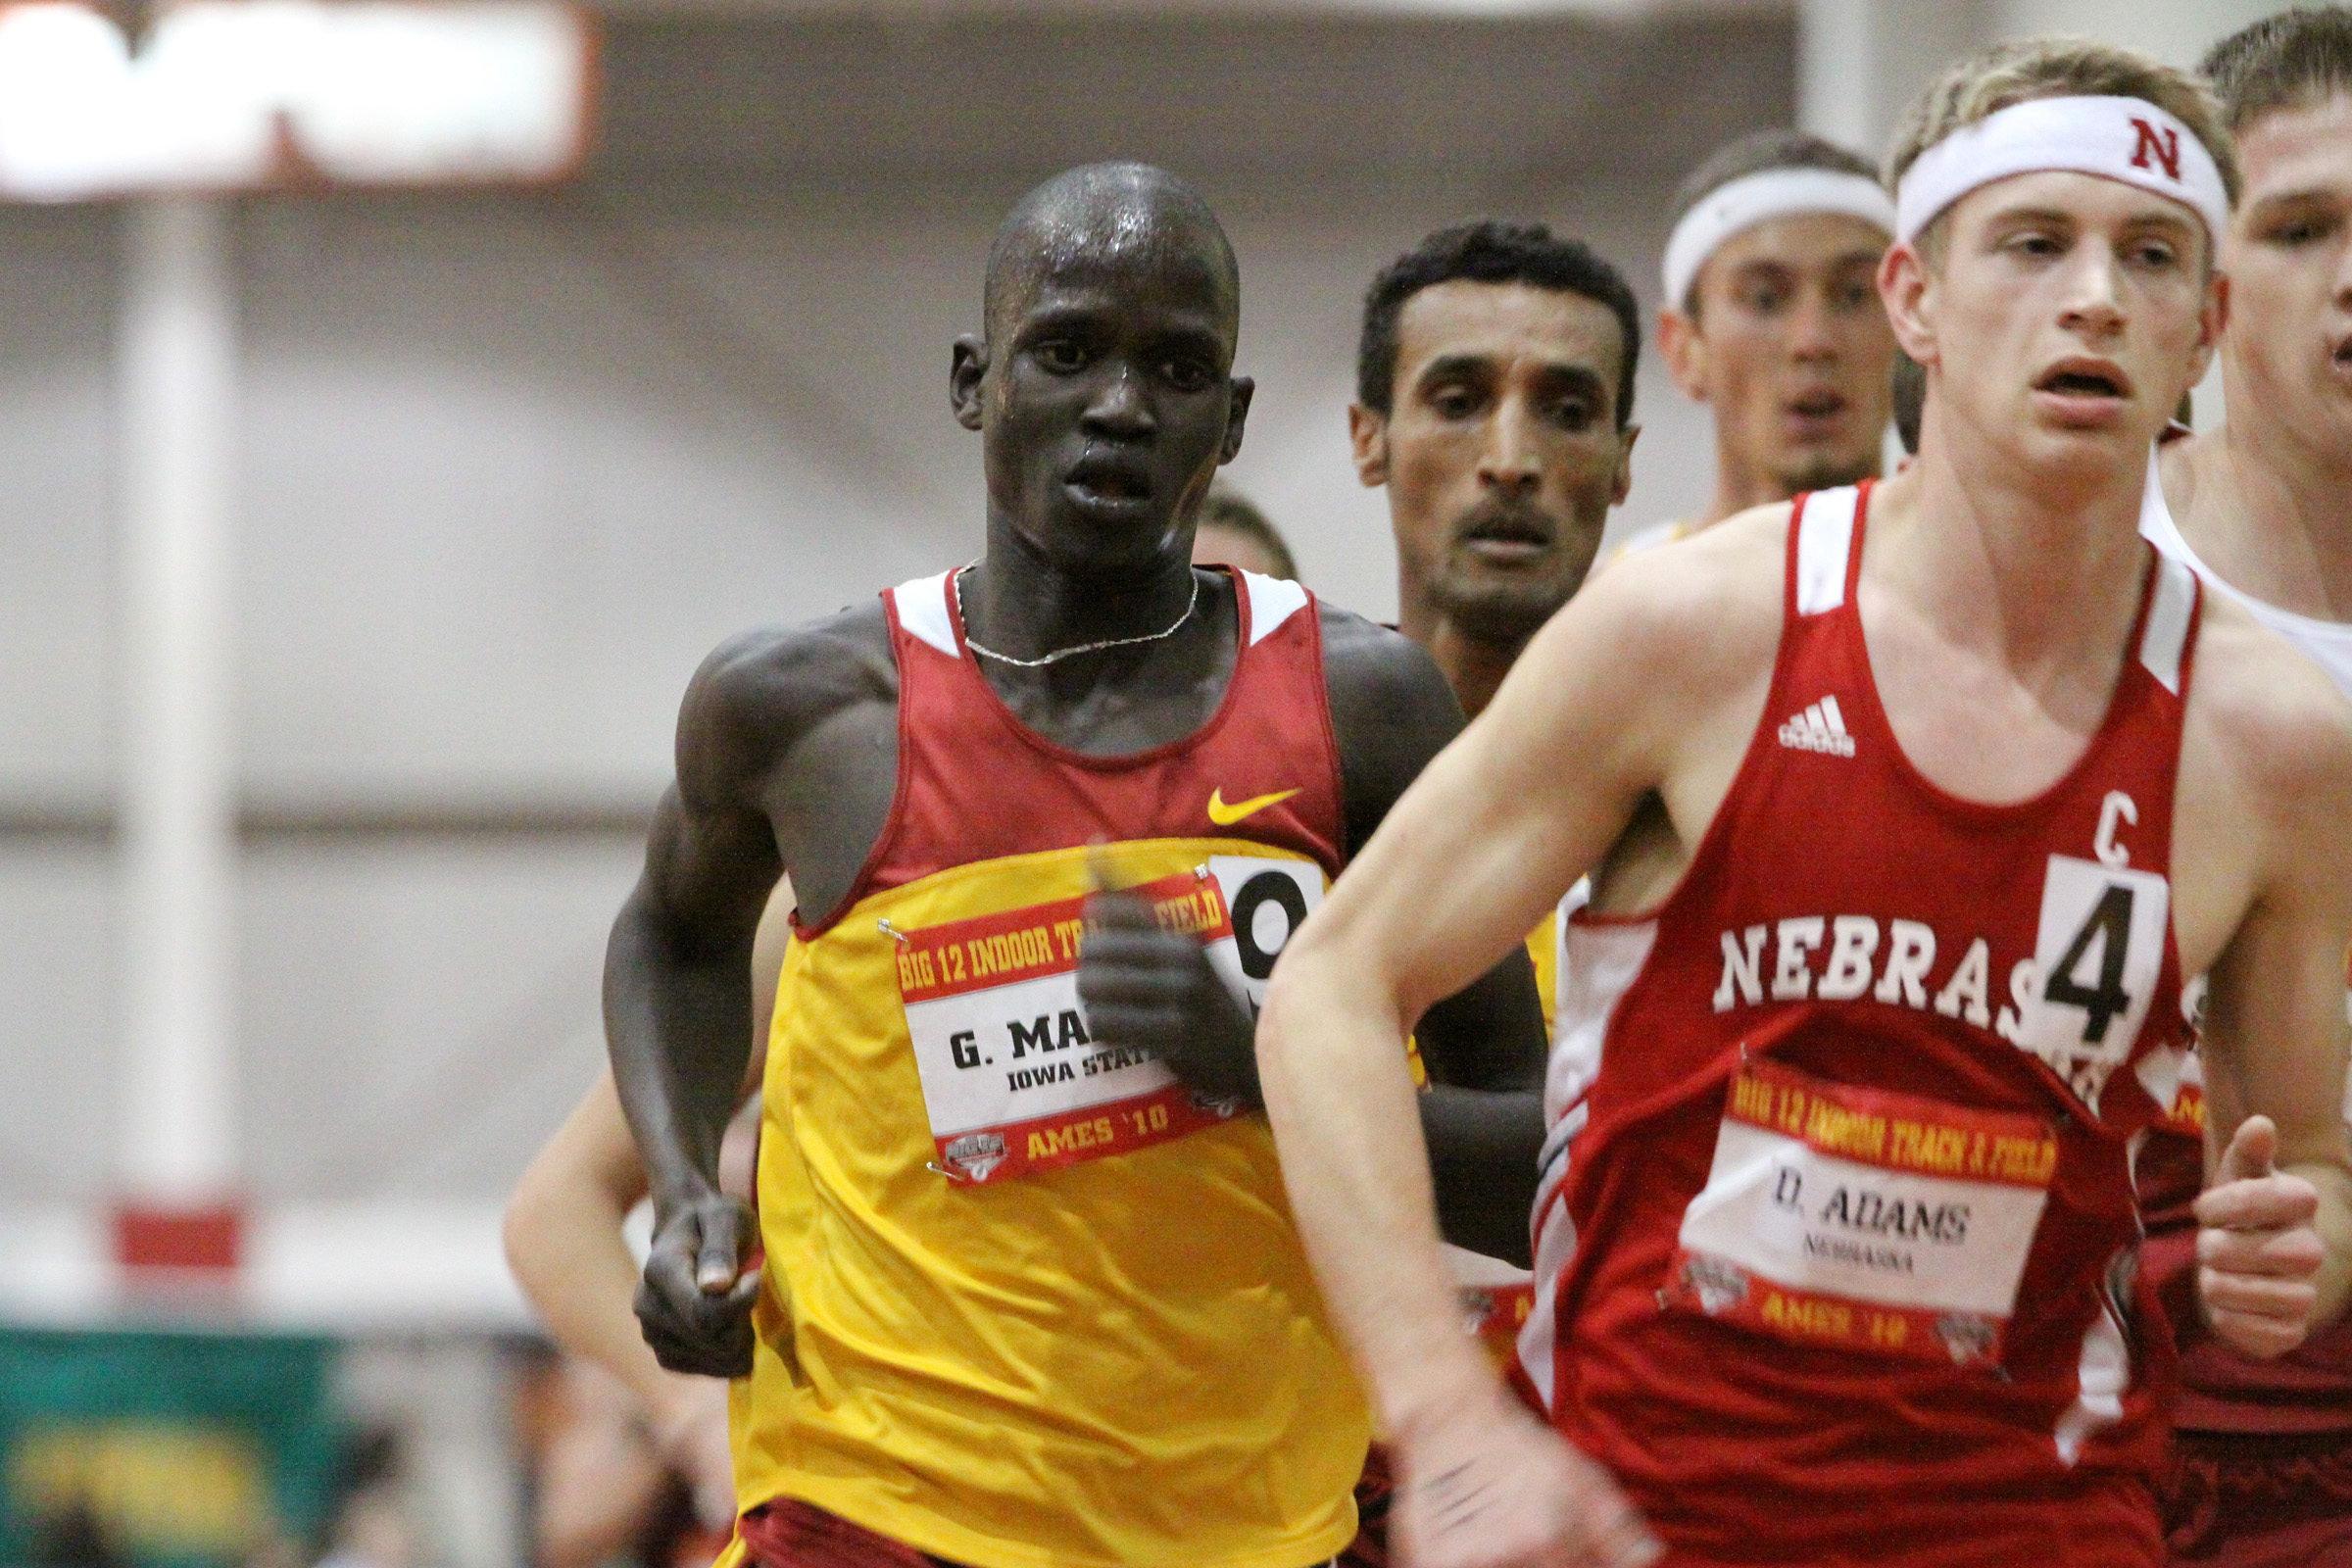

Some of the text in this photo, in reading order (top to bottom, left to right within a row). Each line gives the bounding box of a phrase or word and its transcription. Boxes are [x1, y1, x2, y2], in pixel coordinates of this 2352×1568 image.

[2129, 117, 2181, 180] N
[1778, 723, 1856, 759] adidas
[2094, 790, 2137, 866] C
[898, 950, 936, 992] BIG
[937, 944, 967, 984] 12
[967, 926, 1054, 978] INDOOR
[1154, 890, 1222, 934] FIELD
[2044, 884, 2132, 1043] 4
[1713, 915, 2103, 1098] NEBRAS
[950, 1029, 993, 1069] G.
[1006, 1045, 1158, 1091] IOWA STAT
[1027, 1118, 1114, 1159] AMES
[1820, 1184, 1971, 1245] ADAMS
